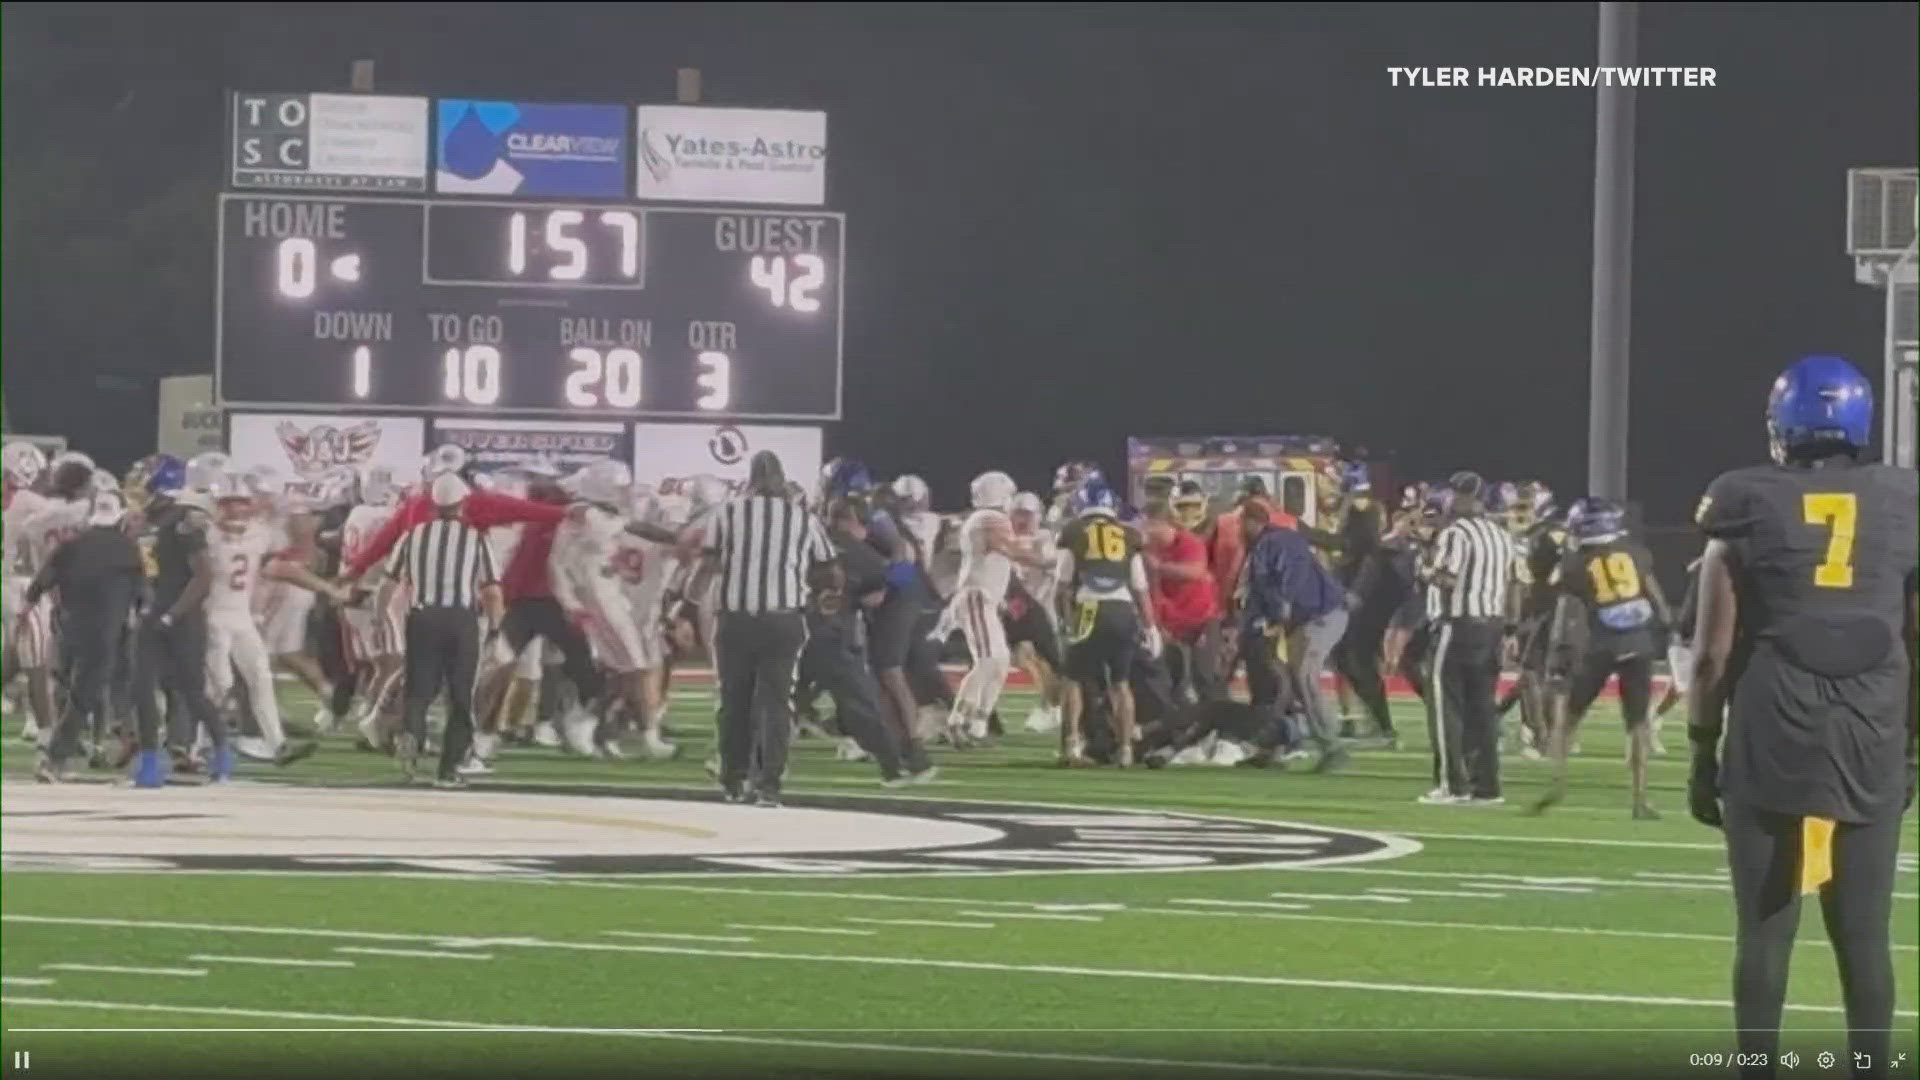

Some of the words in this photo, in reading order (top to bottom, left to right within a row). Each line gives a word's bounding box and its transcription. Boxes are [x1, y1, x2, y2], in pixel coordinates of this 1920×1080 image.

[507, 132, 620, 153] CLEARVIEW
[665, 133, 827, 160] Yates-Astro
[244, 202, 346, 239] HOME
[714, 216, 826, 253] GUEST
[278, 237, 316, 298] 0
[750, 253, 825, 311] 42
[314, 310, 393, 342] DOWN
[428, 313, 461, 343] TO
[467, 313, 503, 343] GO
[559, 316, 615, 347] BALL
[620, 318, 652, 350] ON
[687, 319, 737, 350] QTR
[355, 345, 371, 398] 1
[446, 345, 500, 404] 10
[565, 348, 642, 408] 20
[696, 351, 731, 410] 3
[1084, 522, 1126, 562] 16
[1802, 492, 1857, 587] 7
[229, 553, 248, 591] 2
[1587, 551, 1641, 604] 19
